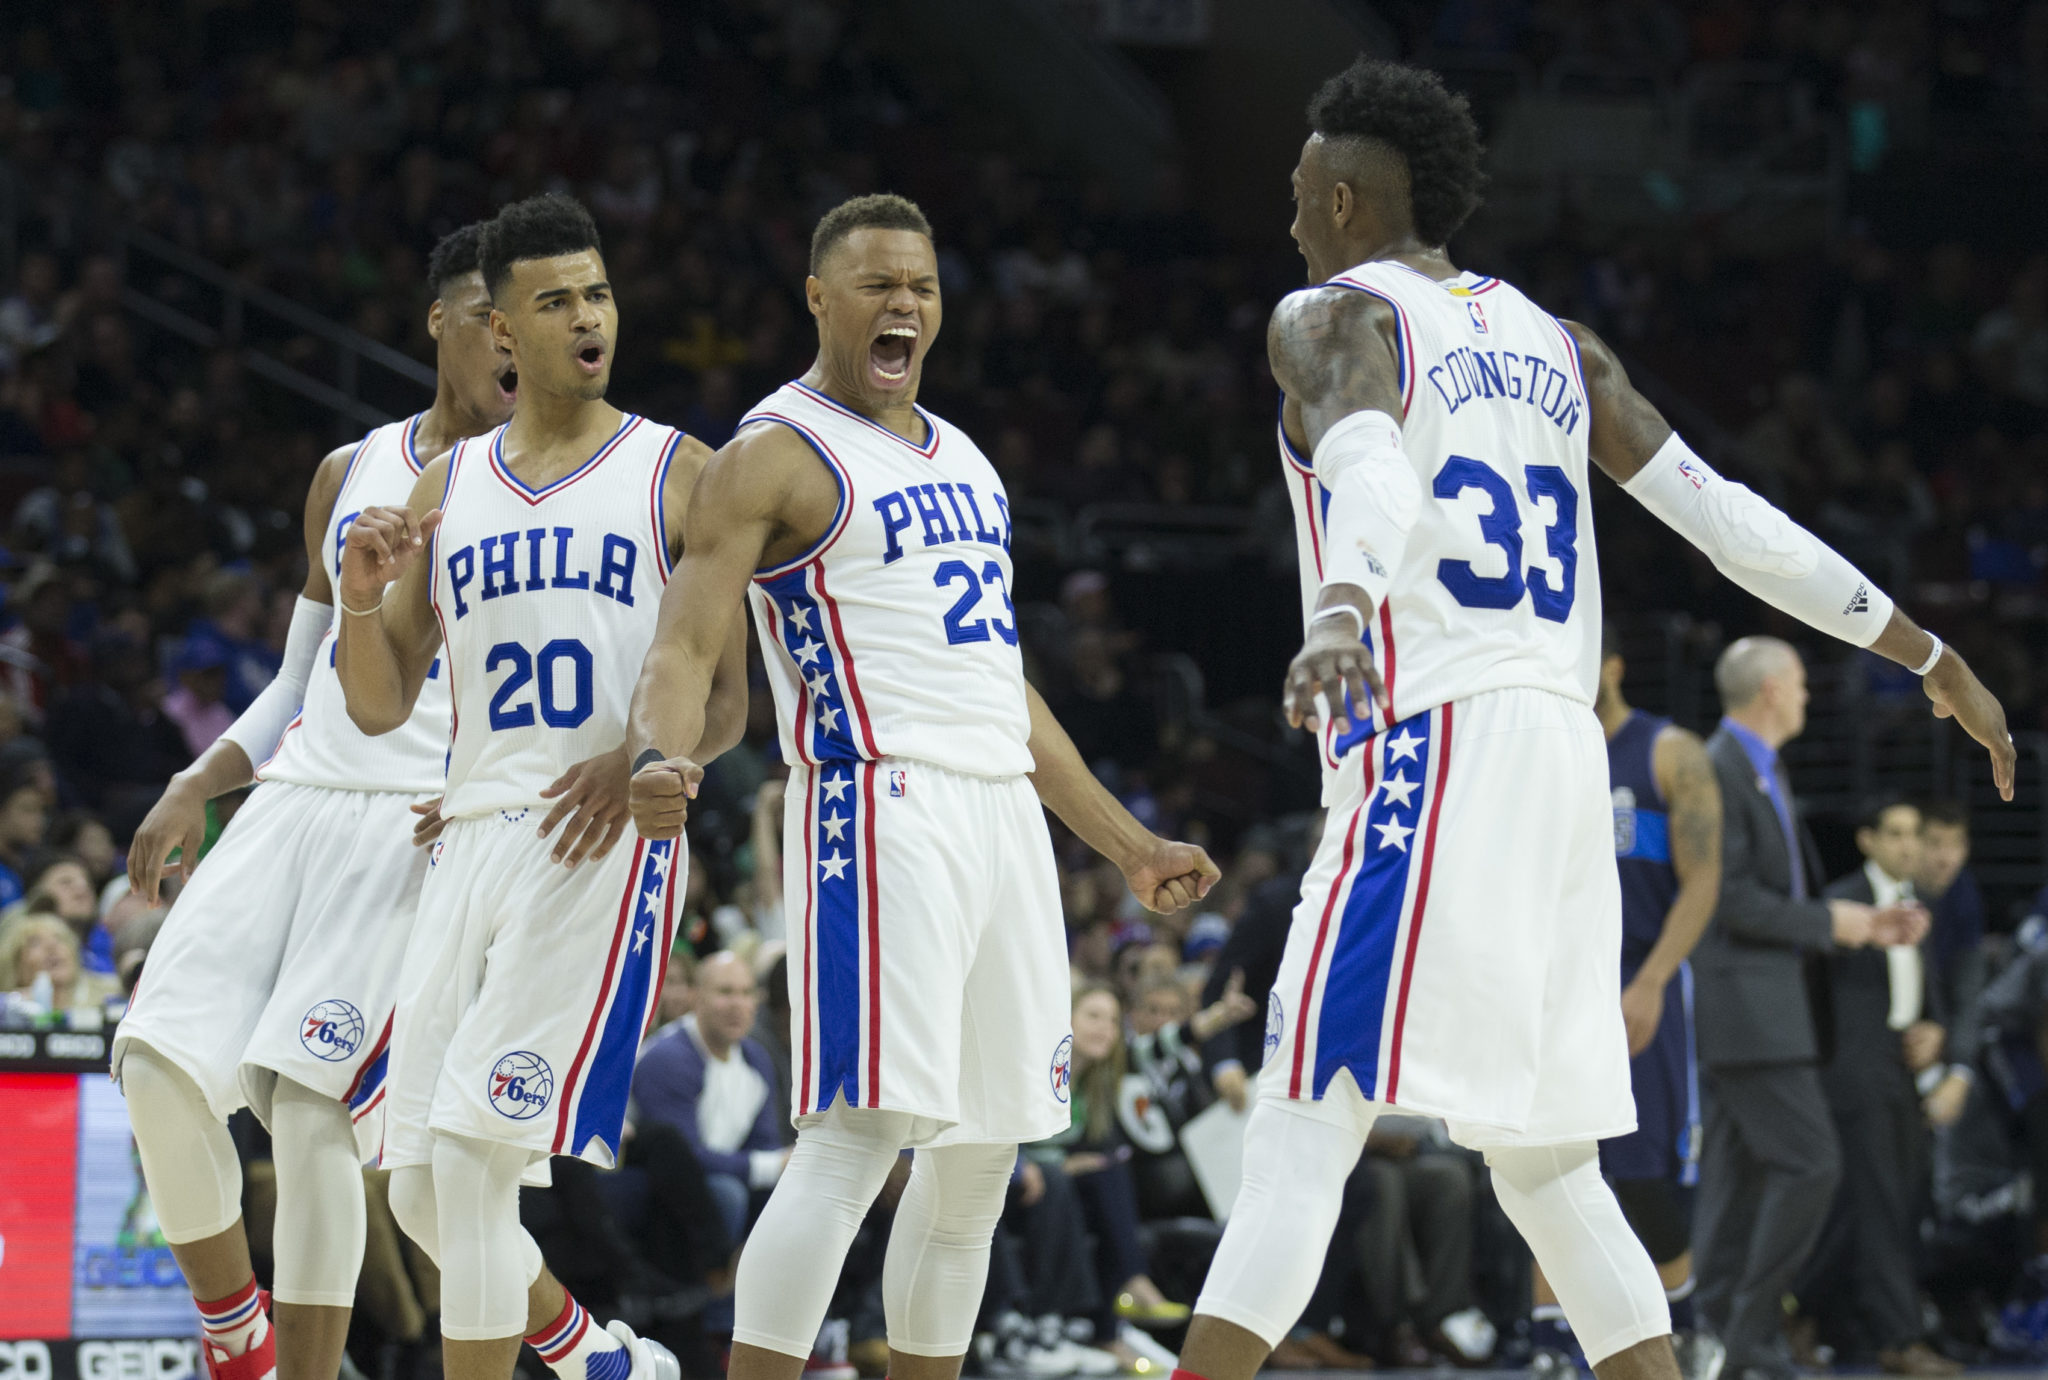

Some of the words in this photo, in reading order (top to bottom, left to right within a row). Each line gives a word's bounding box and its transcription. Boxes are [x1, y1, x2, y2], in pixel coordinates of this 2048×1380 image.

[1427, 346, 1582, 436] COVNGTON
[447, 526, 638, 621] PHILA
[1432, 454, 1579, 624] 33
[933, 560, 1018, 647] 23
[1842, 582, 1865, 616] adidas
[485, 638, 594, 732] 20
[304, 1017, 355, 1053] 76ers
[492, 1072, 547, 1106] 76ers
